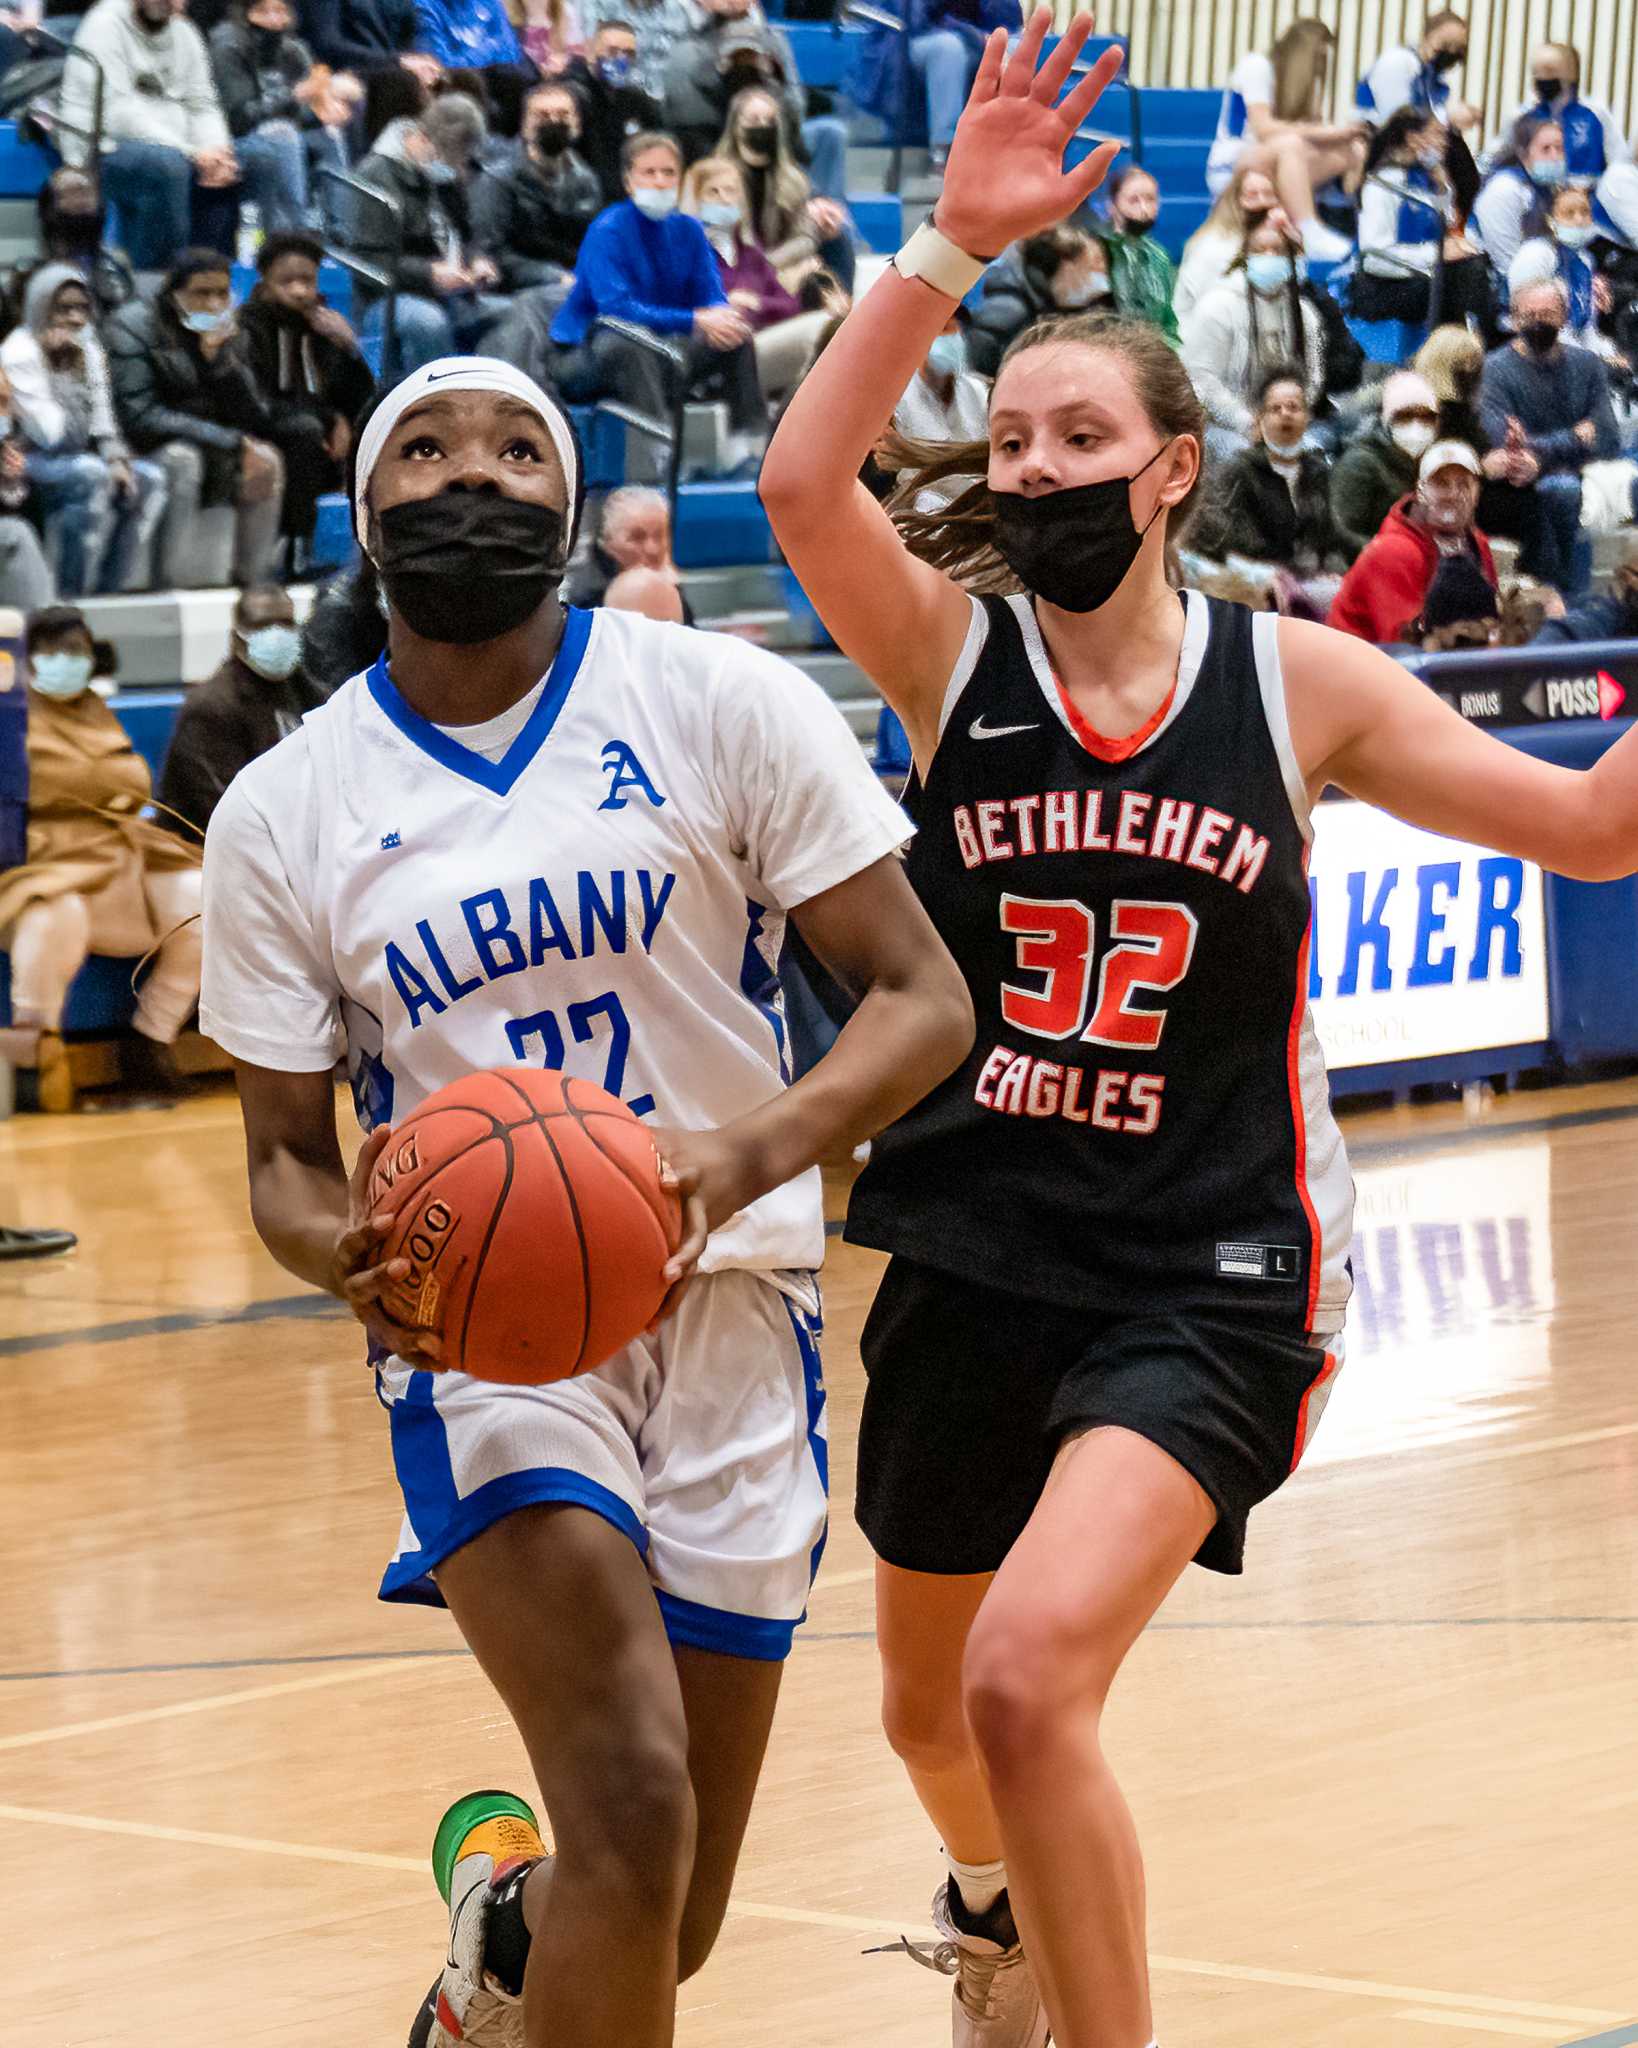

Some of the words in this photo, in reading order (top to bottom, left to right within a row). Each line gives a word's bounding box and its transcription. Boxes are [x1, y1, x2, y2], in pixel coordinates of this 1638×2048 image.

[1460, 690, 1501, 718] BONUS
[1546, 676, 1600, 718] POSS
[598, 739, 667, 811] A
[953, 789, 1271, 894] BETHLEHEM
[384, 869, 676, 1030] ALBANY
[1000, 891, 1199, 1051] 32
[1308, 857, 1525, 1000] KER
[974, 1044, 1166, 1135] EAGLES
[1276, 1255, 1287, 1272] L
